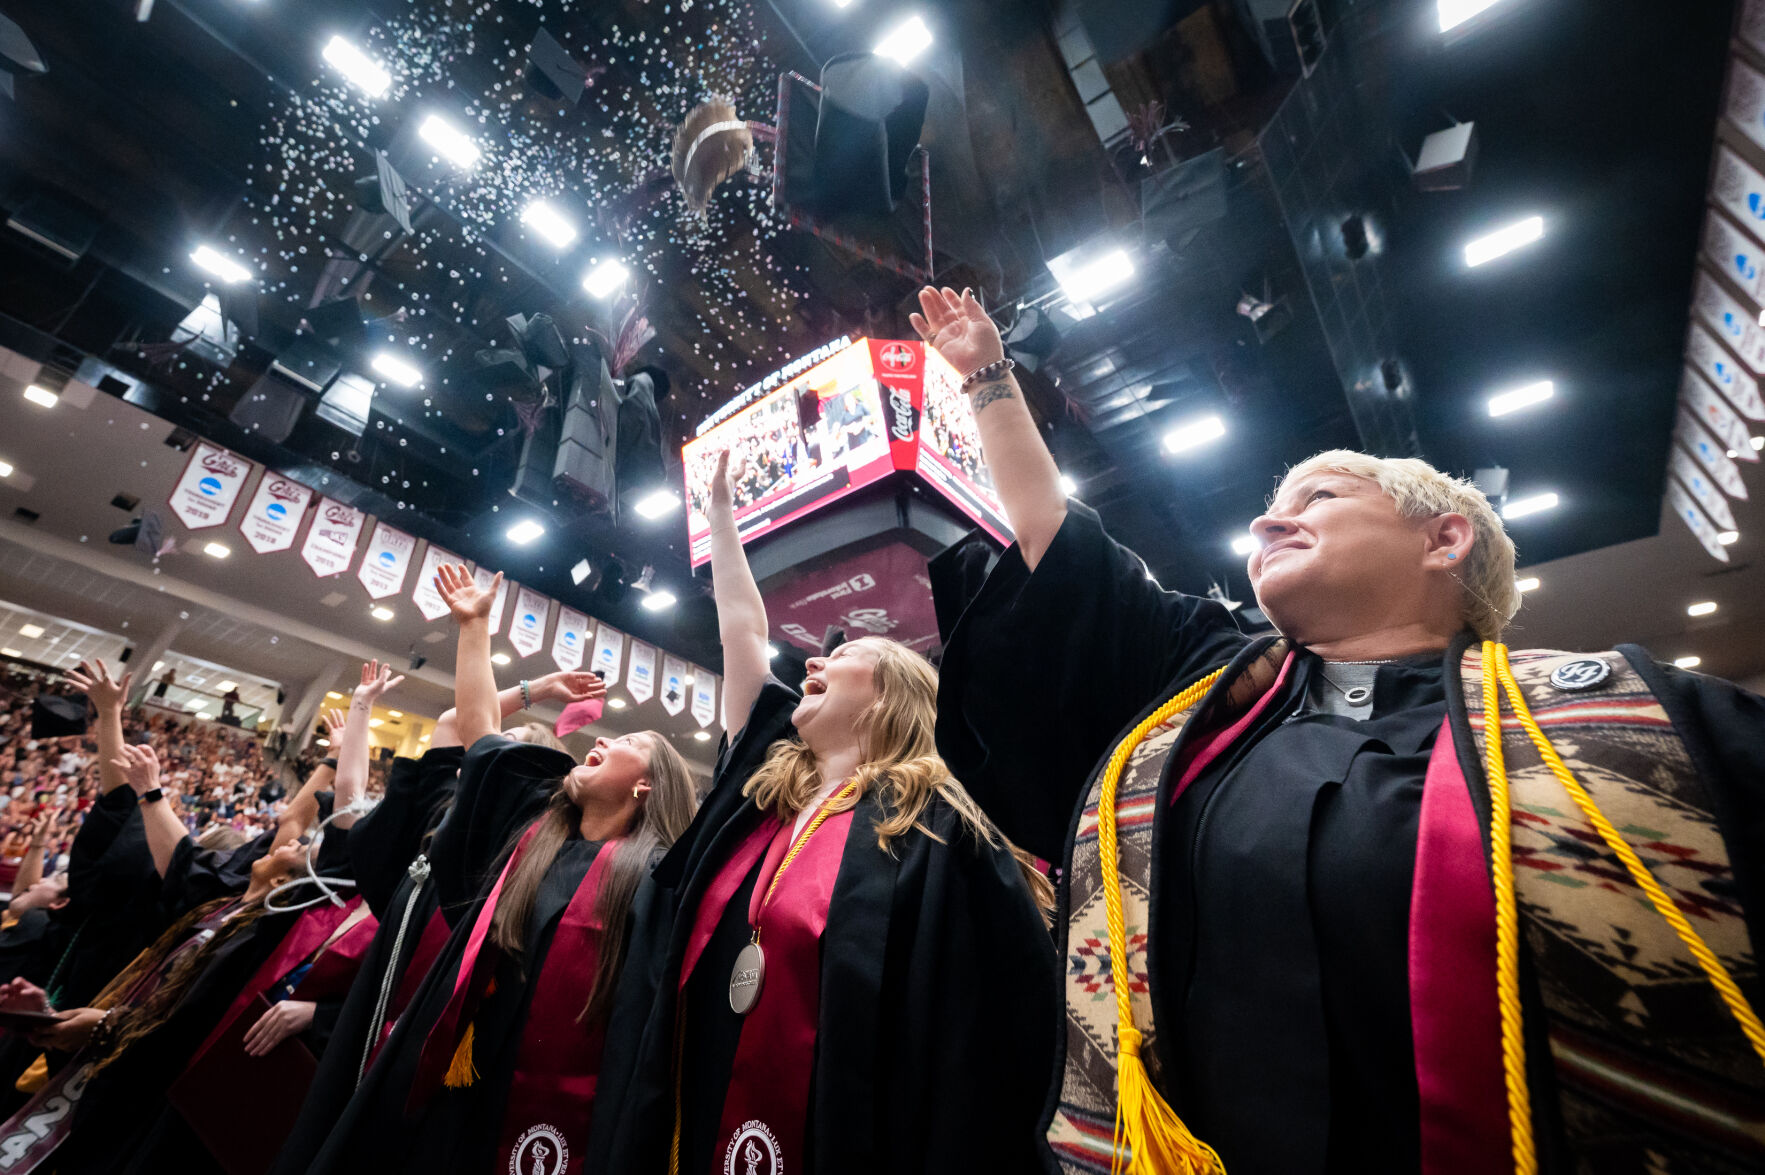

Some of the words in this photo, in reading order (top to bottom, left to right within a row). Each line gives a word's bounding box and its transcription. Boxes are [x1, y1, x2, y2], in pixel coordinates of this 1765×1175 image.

[781, 334, 852, 380] MONTANA
[527, 1123, 558, 1136] MONTANA
[558, 1132, 568, 1148] LUX
[733, 1127, 741, 1140] OF
[742, 1119, 770, 1136] MONTANA
[771, 1135, 782, 1155] LUX
